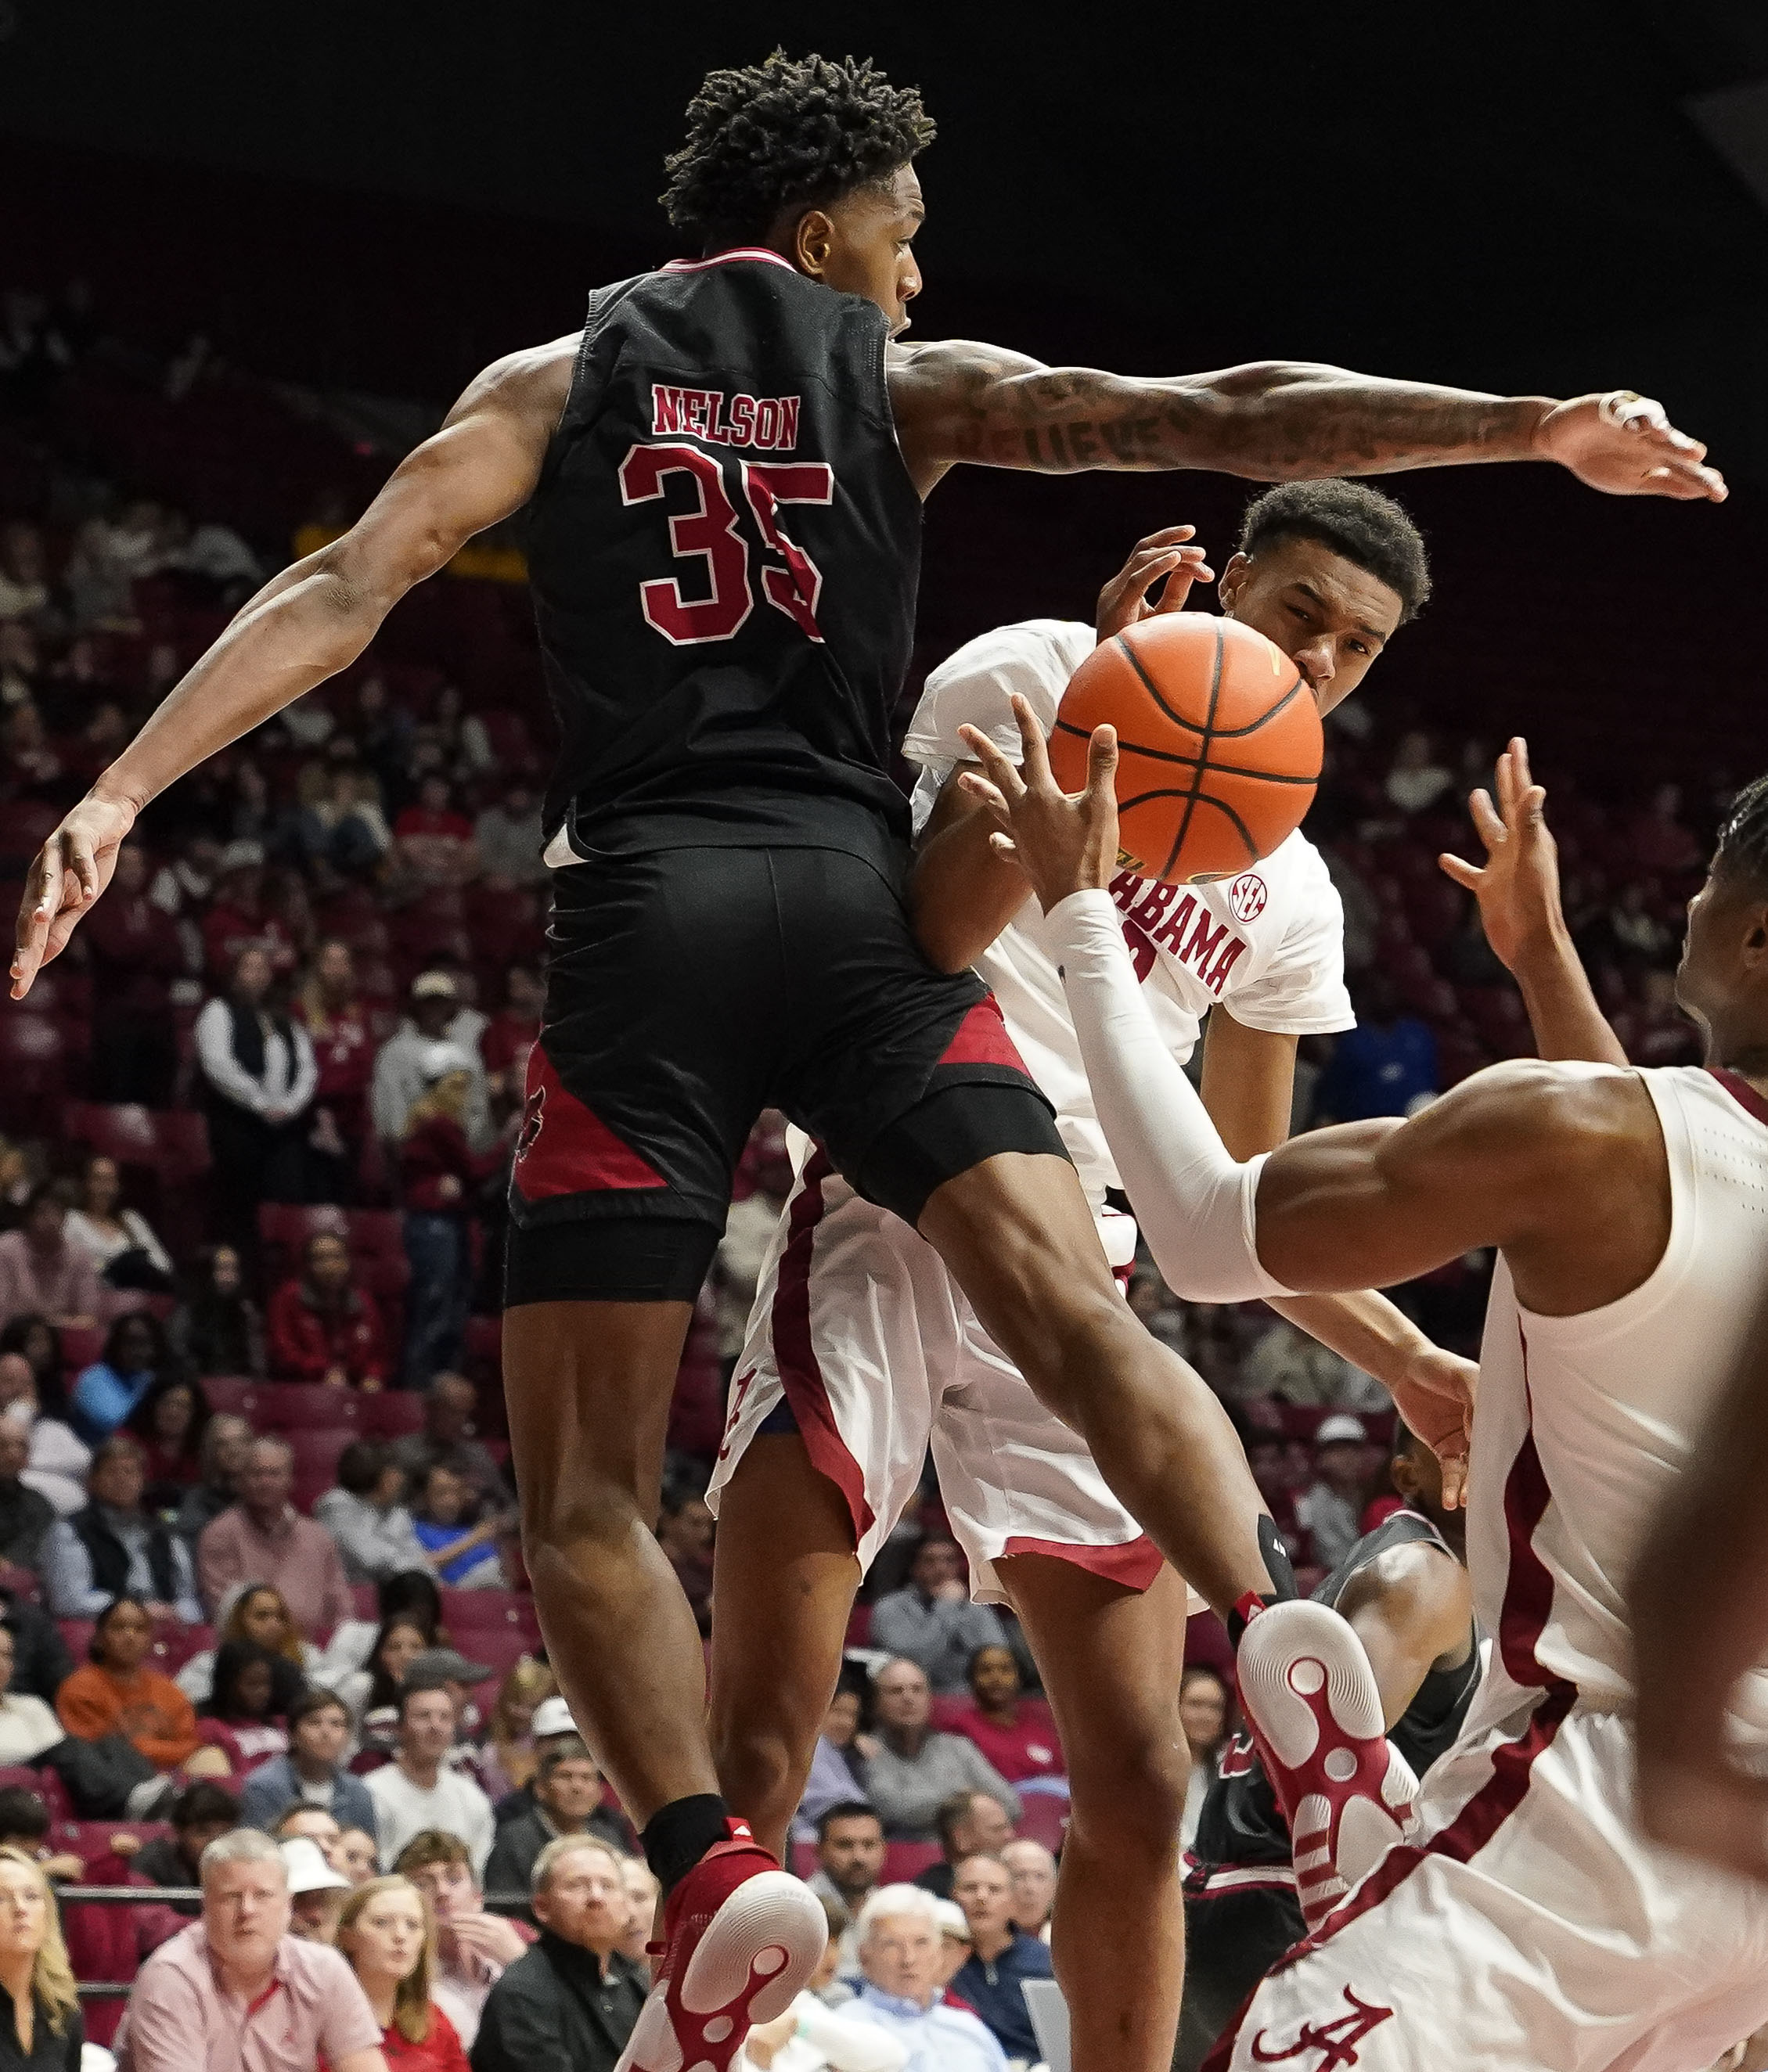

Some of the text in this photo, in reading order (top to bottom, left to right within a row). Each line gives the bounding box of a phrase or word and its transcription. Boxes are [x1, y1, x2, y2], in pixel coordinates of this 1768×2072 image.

[652, 383, 800, 450] NELSON
[618, 442, 834, 646] 35
[1233, 875, 1266, 921] SEC
